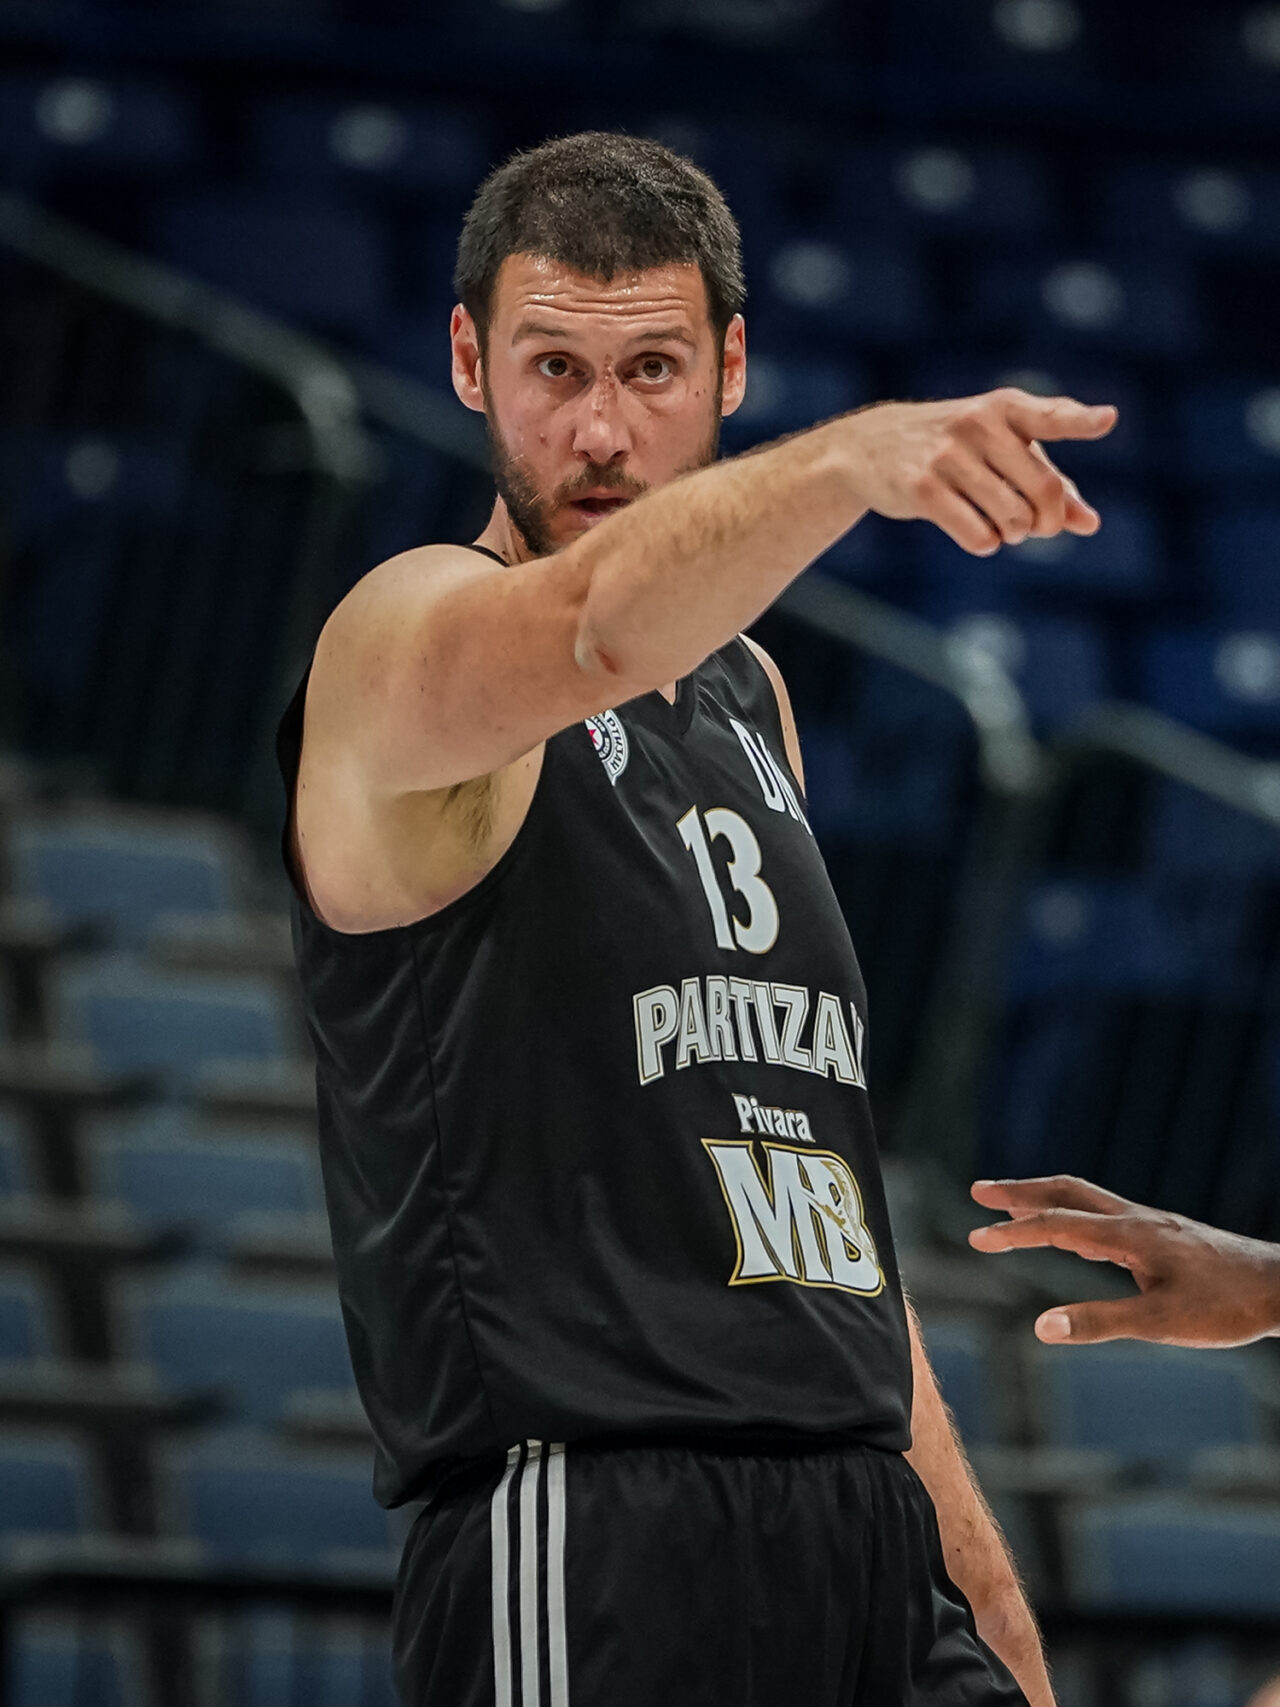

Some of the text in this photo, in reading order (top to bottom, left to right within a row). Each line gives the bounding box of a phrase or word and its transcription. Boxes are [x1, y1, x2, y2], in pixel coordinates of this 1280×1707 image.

[676, 804, 779, 954] 13
[731, 1093, 816, 1143] Pivara
[701, 1138, 886, 1297] MB
